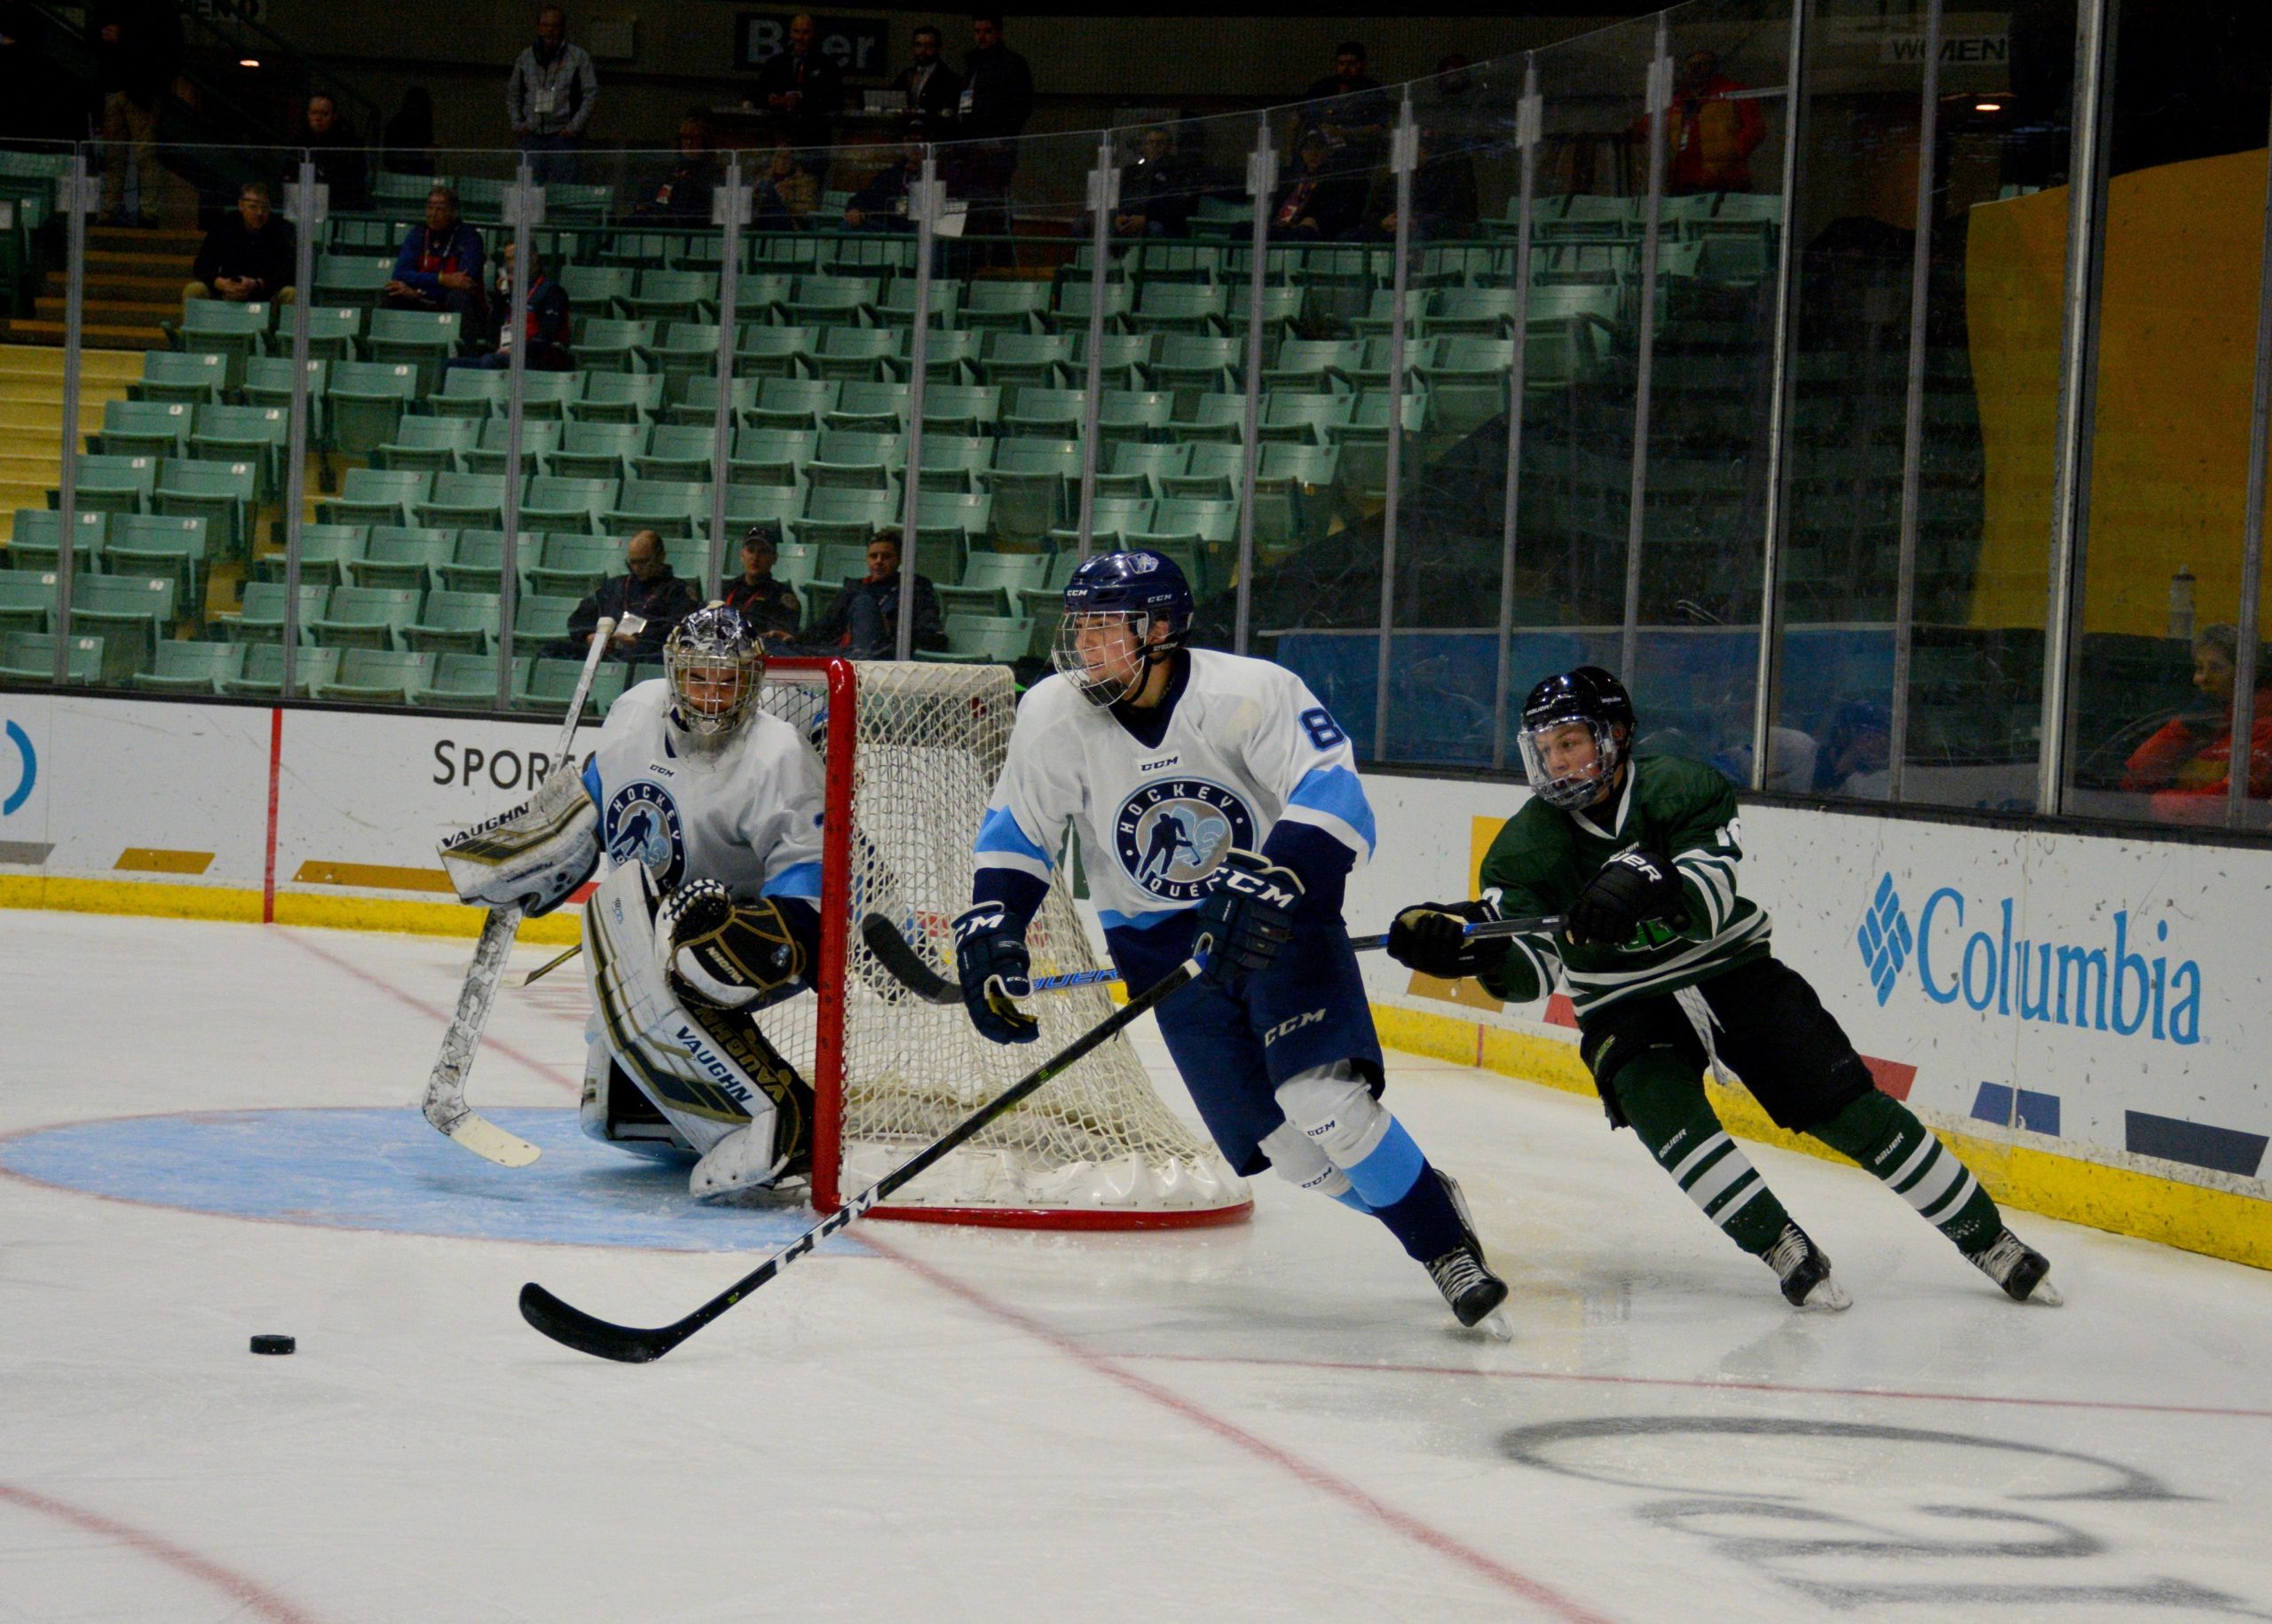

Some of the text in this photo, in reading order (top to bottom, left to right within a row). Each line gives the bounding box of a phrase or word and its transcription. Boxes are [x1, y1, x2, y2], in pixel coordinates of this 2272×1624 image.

[747, 18, 876, 69] Ber
[1148, 594, 1172, 603] CCM
[1298, 707, 1346, 753] 8
[434, 740, 596, 792] SPOR
[650, 764, 674, 777] CCM
[1141, 756, 1178, 772] CCM
[441, 801, 530, 848] VAUGHN
[612, 785, 681, 840] HOCKEY
[1120, 784, 1234, 834] HOCKEY
[1149, 877, 1221, 898] QUÉ
[1212, 866, 1295, 908] CM
[1917, 887, 2201, 1045] Columbia
[1265, 1008, 1327, 1048] CCM
[676, 1026, 753, 1102] VAUGHN
[1307, 1119, 1336, 1138] CCM
[1301, 1166, 1332, 1188] CCM
